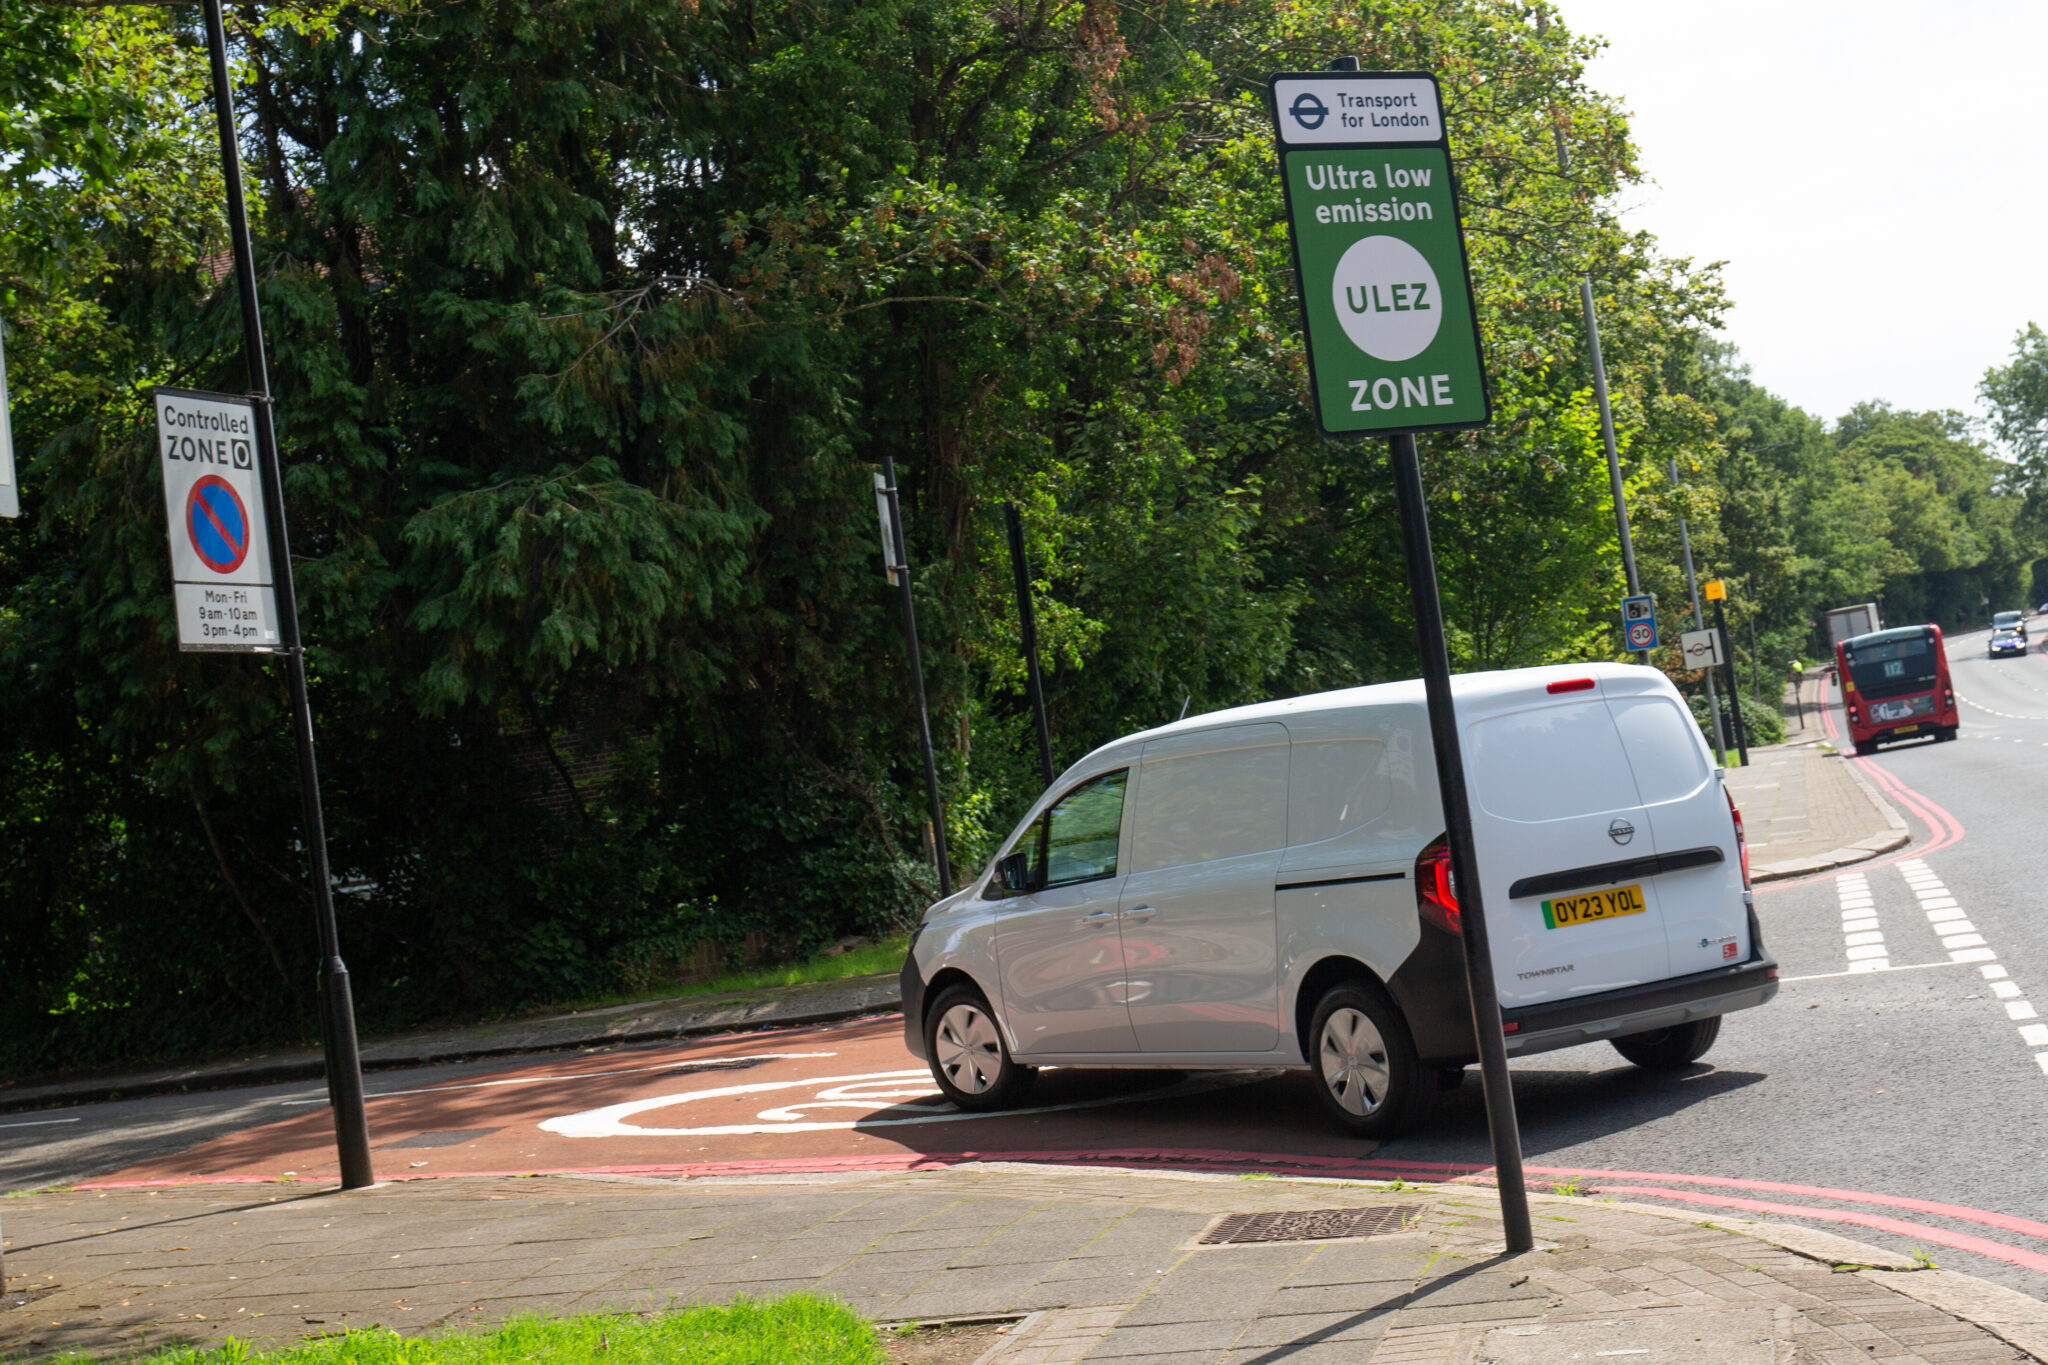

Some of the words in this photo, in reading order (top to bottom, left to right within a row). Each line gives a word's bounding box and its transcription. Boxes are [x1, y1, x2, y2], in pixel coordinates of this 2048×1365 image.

[1337, 92, 1417, 110] Transport
[1341, 113, 1364, 128] for
[1371, 112, 1429, 128] London
[1305, 164, 1377, 191] Ultra
[1384, 163, 1431, 188] low
[1315, 197, 1433, 224] emission
[1346, 283, 1431, 314] ULEZ
[1348, 374, 1454, 412] ZONE
[164, 405, 249, 434] Controlled
[167, 435, 228, 465] ZONE
[1633, 628, 1650, 640] 30
[1884, 660, 1904, 677] 112
[1555, 896, 1604, 923] OY23
[1605, 889, 1642, 913] YOL
[1516, 964, 1574, 981] TOWNSTAR
